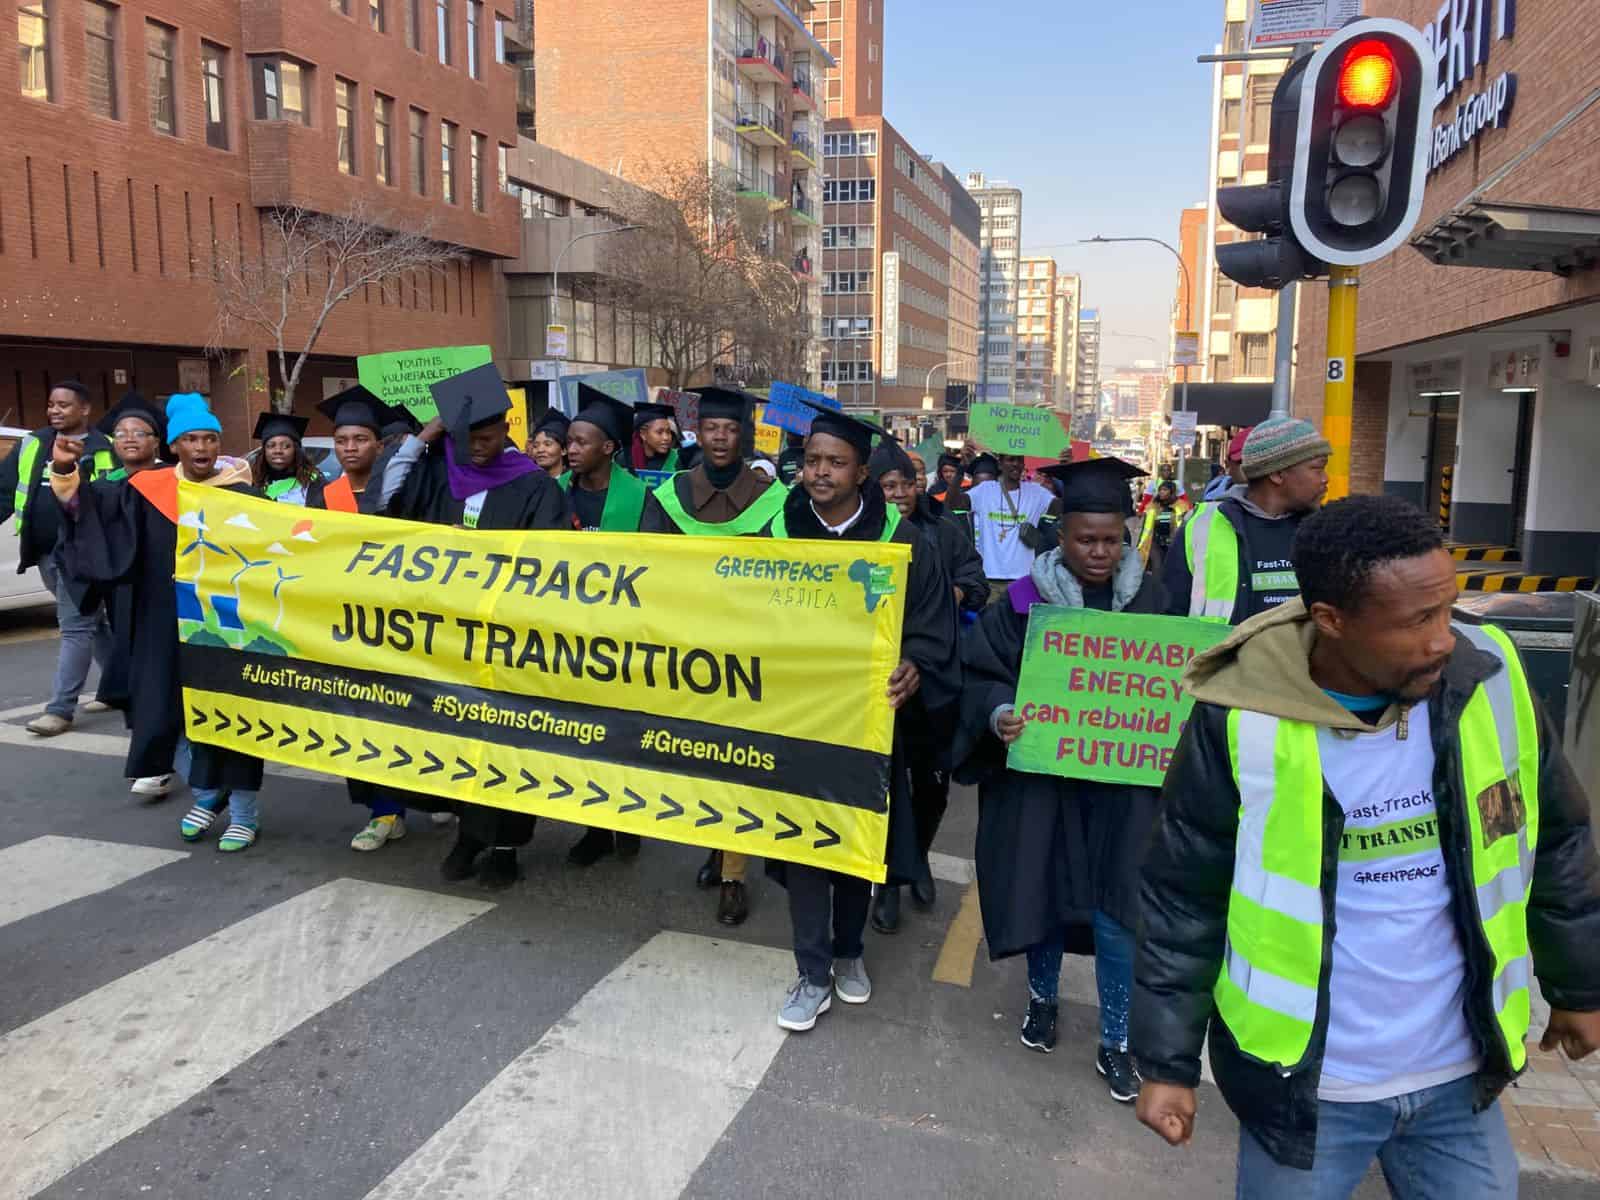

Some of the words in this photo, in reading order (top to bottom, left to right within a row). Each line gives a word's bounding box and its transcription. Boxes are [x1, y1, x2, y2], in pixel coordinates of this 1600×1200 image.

[1434, 105, 1466, 167] Bank
[1464, 72, 1514, 142] Group
[397, 358, 431, 370] YOUTH
[432, 356, 442, 366] IS
[1327, 359, 1343, 380] 8
[989, 407, 1008, 418] NO
[996, 424, 1041, 436] without
[344, 541, 649, 609] FAST-TRACK
[715, 556, 840, 583] GREENPEACE
[332, 603, 445, 657] JUST
[456, 618, 762, 703] TRANSITION
[1068, 667, 1184, 703] ENERGY
[241, 663, 412, 708] #JustTransitionNow
[432, 694, 607, 745] #SystemsChange
[640, 730, 776, 771] #GreenJobs
[1021, 702, 1070, 725] can
[1078, 705, 1171, 734] rebuild
[1056, 737, 1175, 772] FUTURE
[1357, 819, 1439, 850] TRANSI
[1353, 864, 1440, 884] GREENPEACE
